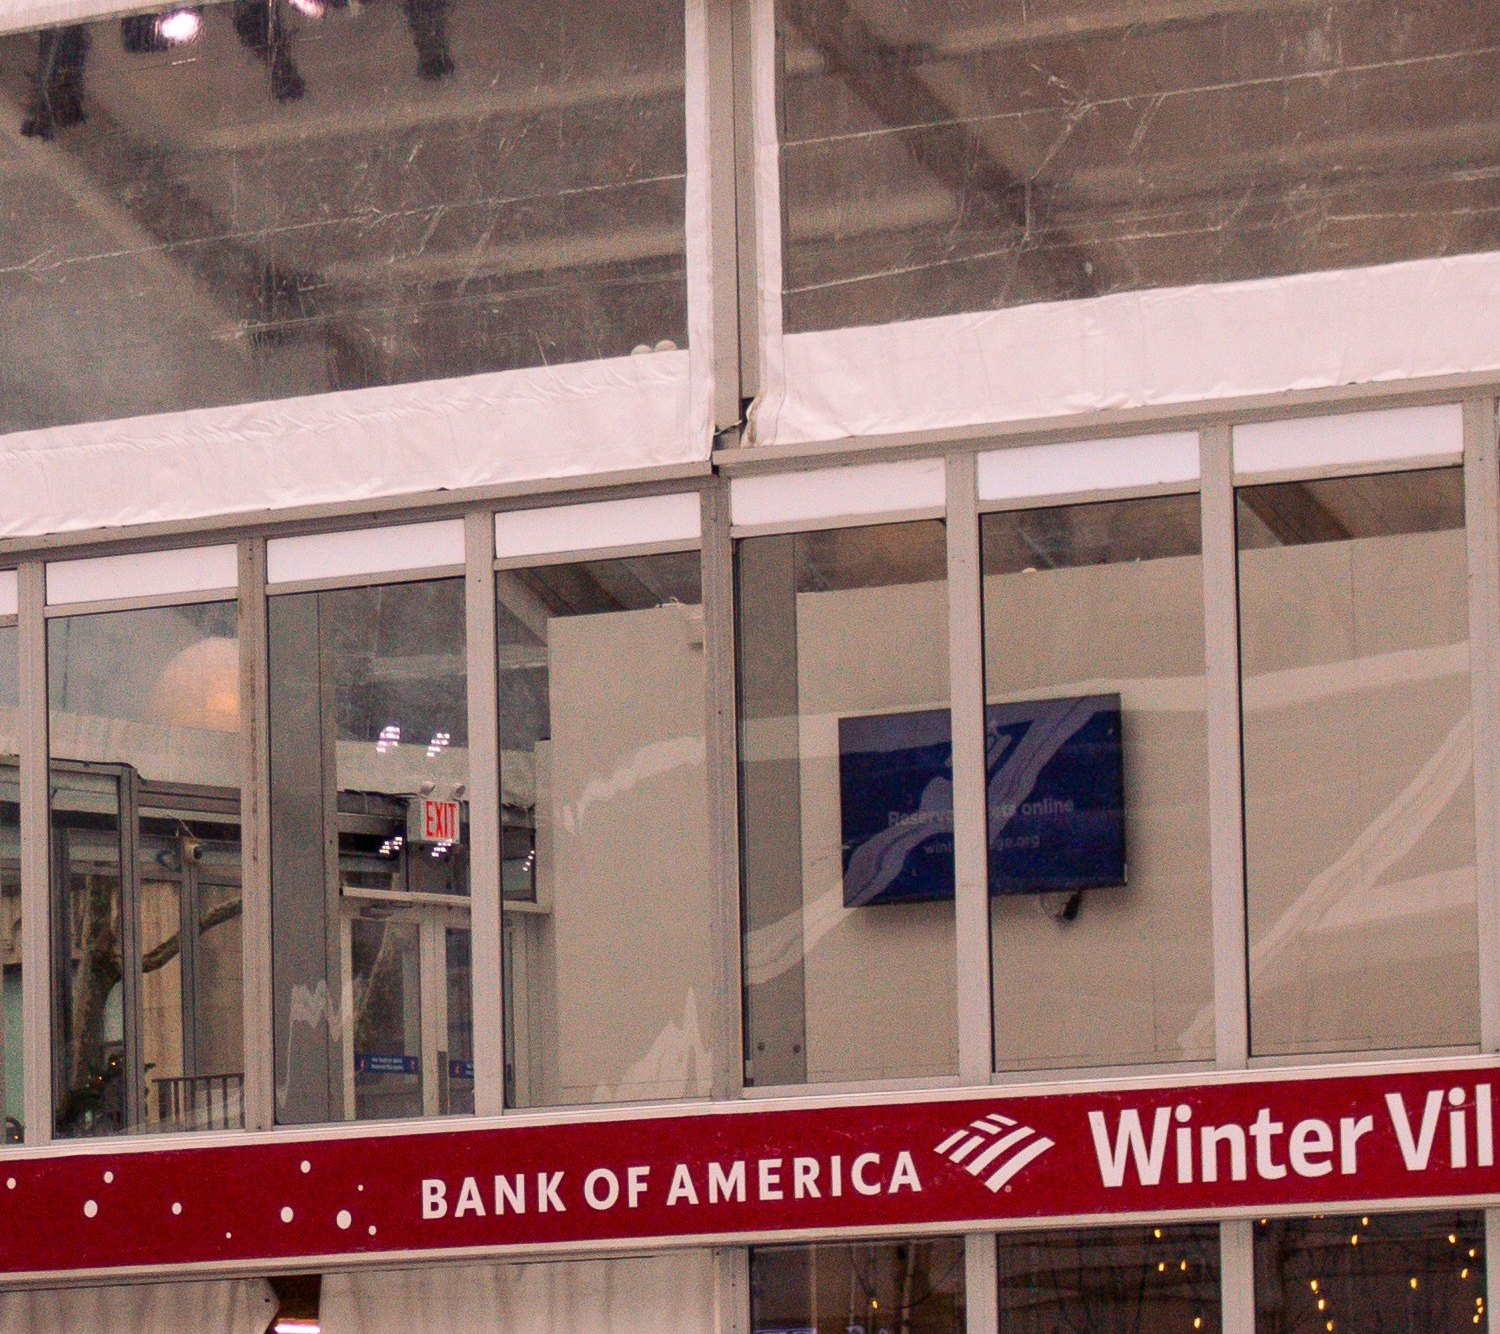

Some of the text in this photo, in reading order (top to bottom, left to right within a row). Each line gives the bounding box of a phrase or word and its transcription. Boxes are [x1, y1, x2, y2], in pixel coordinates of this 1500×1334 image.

[424, 800, 457, 841] EXIT
[1021, 798, 1075, 817] online
[1087, 1102, 1374, 1188] Winter
[420, 1150, 923, 1220] BANK OF AMERICA
